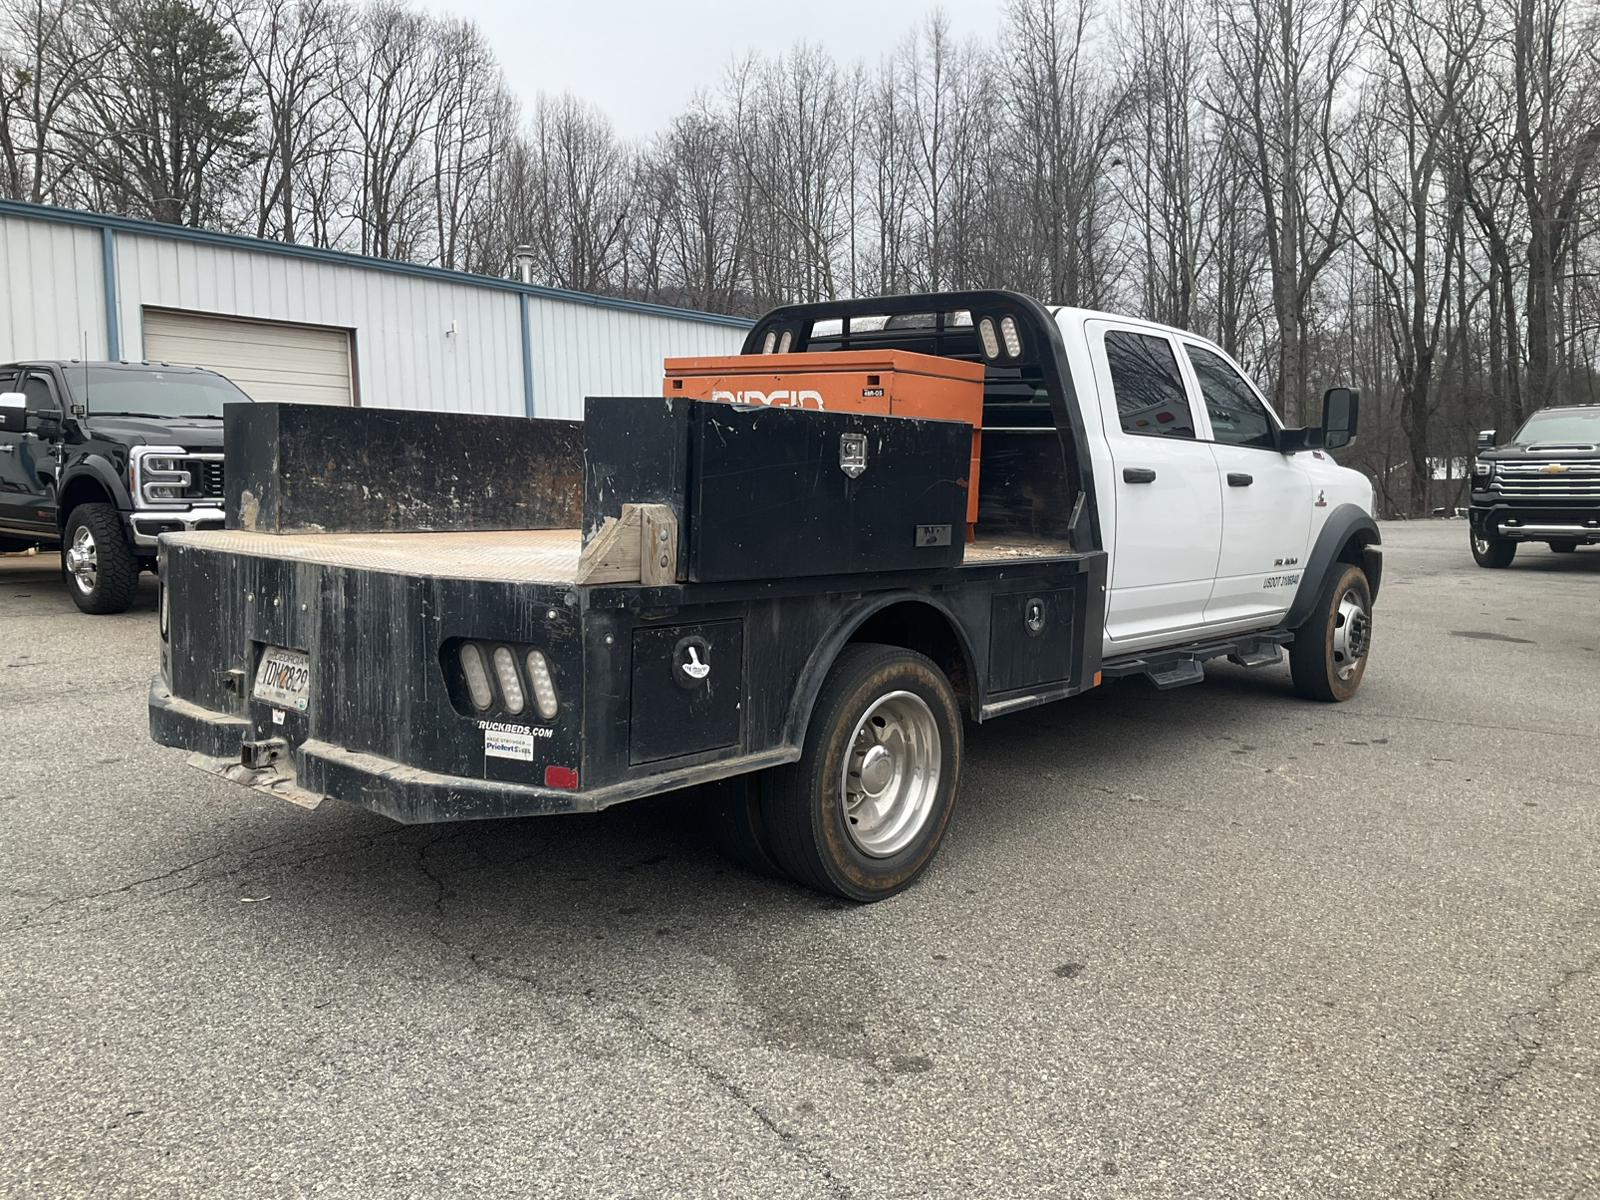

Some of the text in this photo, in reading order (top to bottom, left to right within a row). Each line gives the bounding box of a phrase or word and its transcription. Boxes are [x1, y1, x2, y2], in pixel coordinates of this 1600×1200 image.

[1274, 557, 1298, 566] RAM
[1263, 576, 1281, 589] USDOT
[274, 652, 304, 666] GEORGIA
[263, 660, 308, 693] TDH2829
[477, 720, 553, 738] RUCKBEDS.COM
